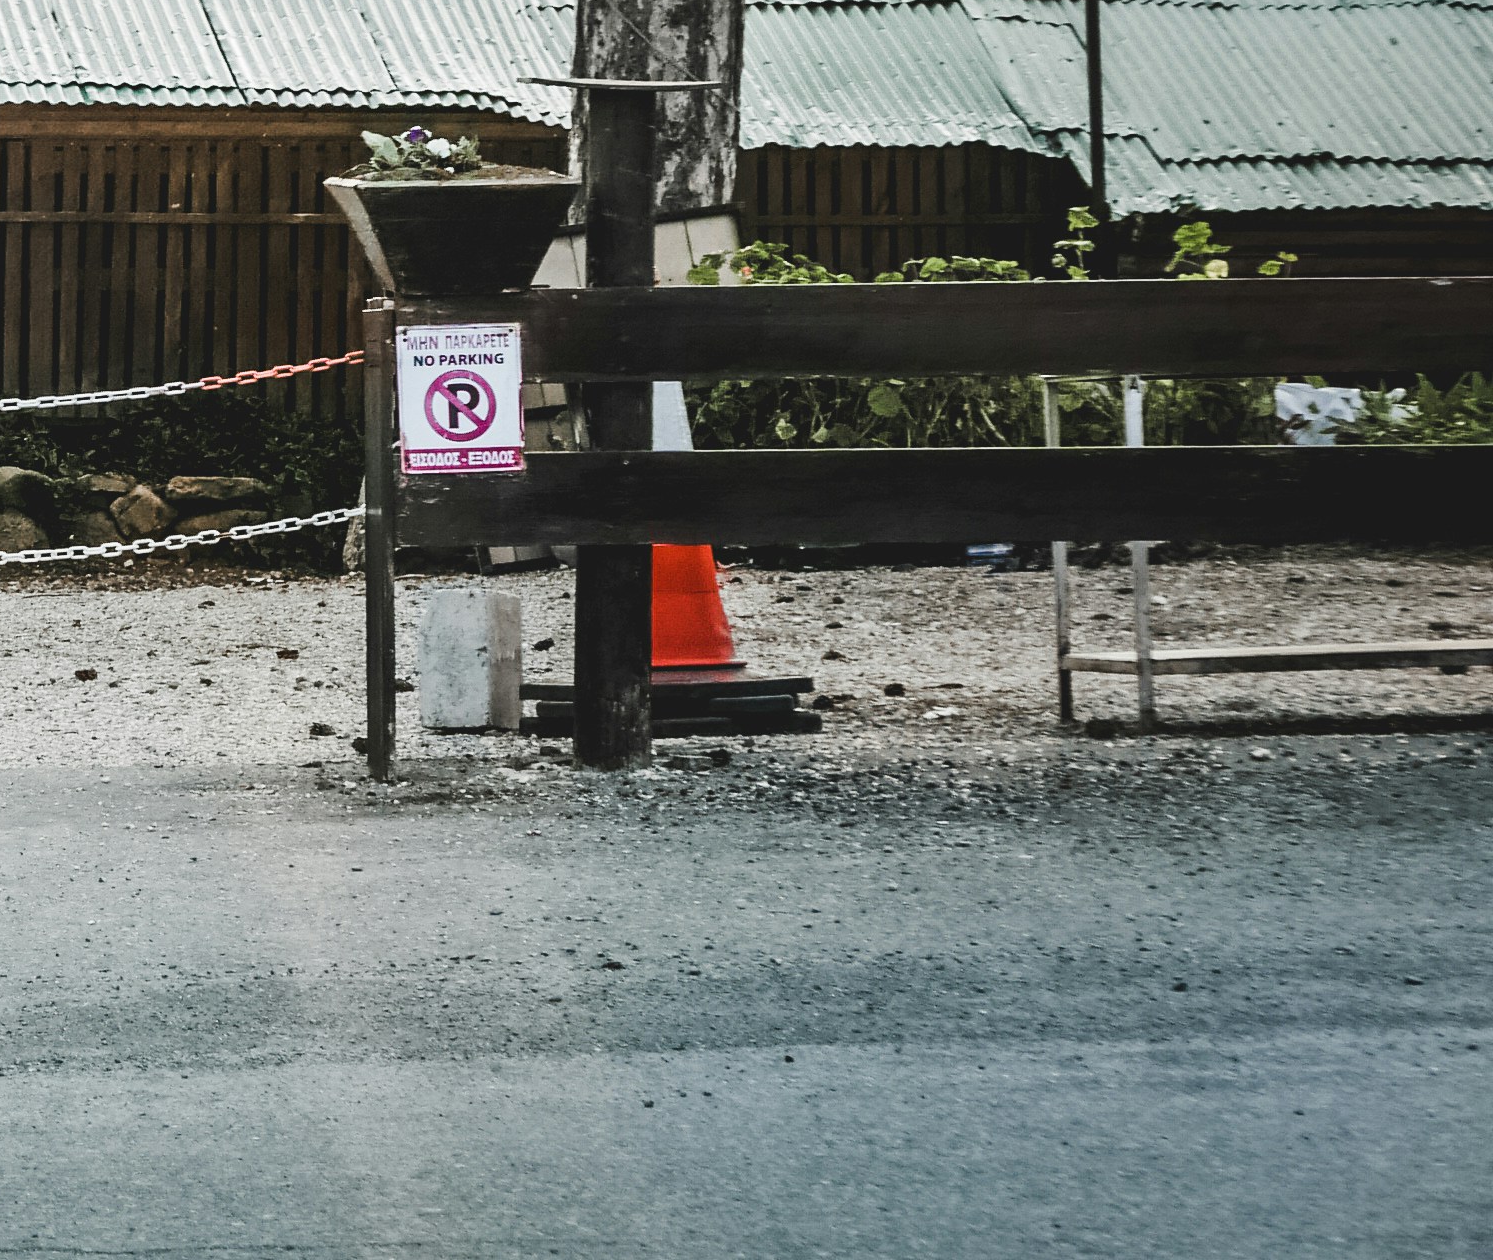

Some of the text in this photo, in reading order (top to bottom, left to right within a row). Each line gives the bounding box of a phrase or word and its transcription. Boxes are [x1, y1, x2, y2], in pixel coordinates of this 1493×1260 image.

[407, 333, 510, 351] ΜΗΝ ΠΑΡΚΑΡΕΤΕ
[413, 353, 505, 367] NO PARKING
[409, 451, 461, 467] ΕΙΣΟΔΟΣ
[468, 450, 516, 465] ΕΞΟΔΟΣ
